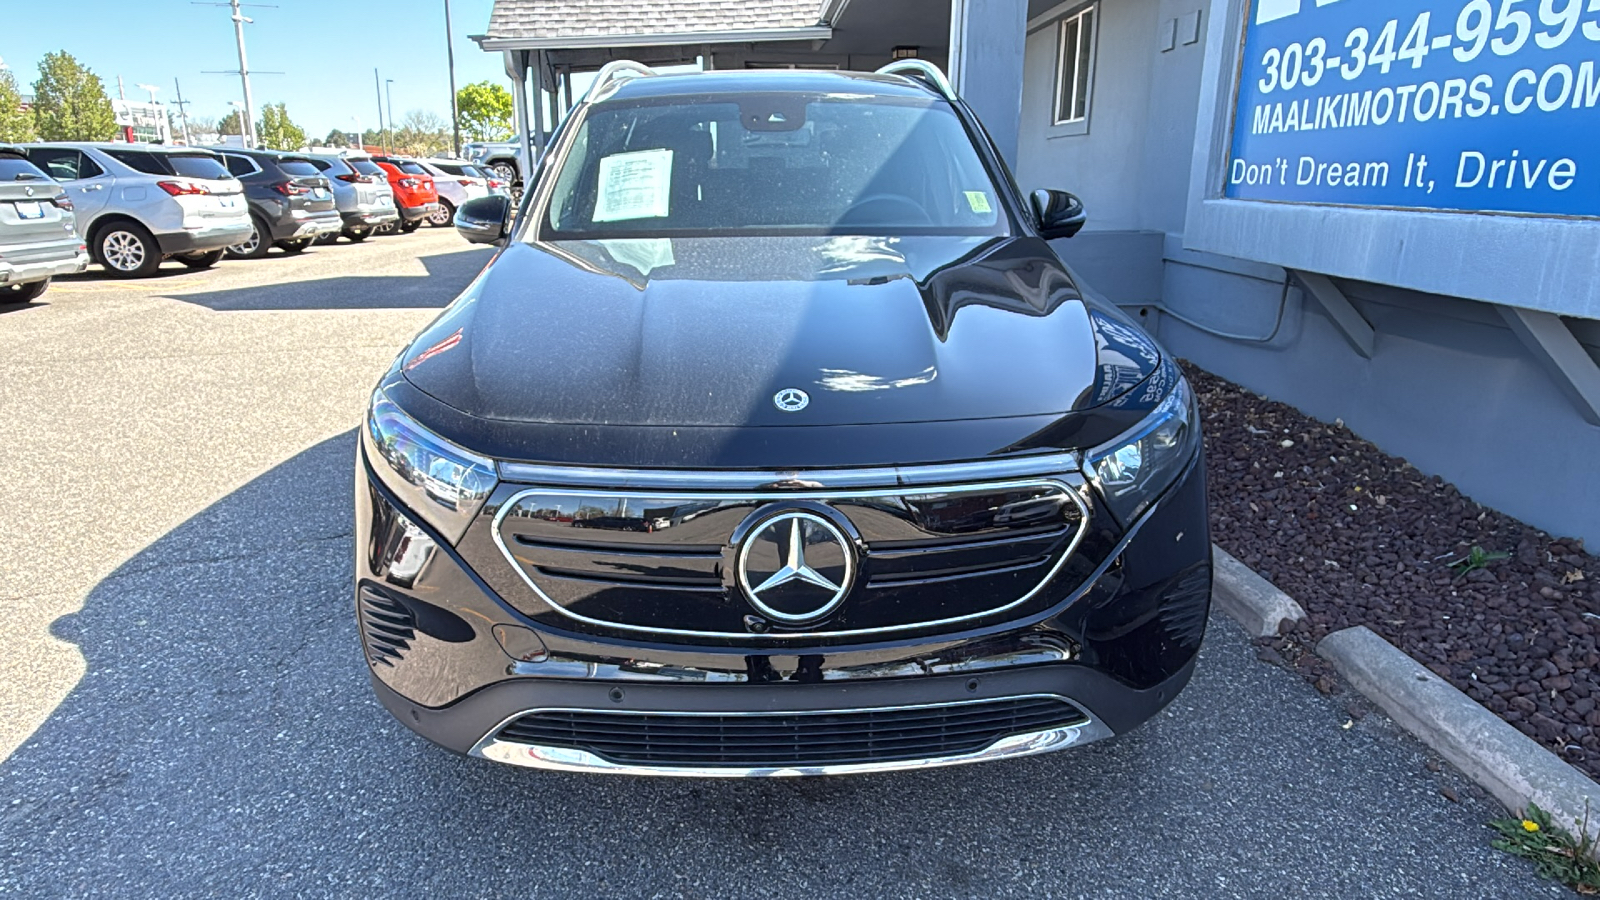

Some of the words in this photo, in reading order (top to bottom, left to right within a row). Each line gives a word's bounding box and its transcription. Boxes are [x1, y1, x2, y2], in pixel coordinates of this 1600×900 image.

[1252, 61, 1600, 134] MAALIKIMOTORS.COM
[1231, 157, 1288, 186] Don't
[1296, 156, 1389, 187] Dream
[1404, 152, 1435, 194] It,
[1455, 150, 1577, 191] Drive
